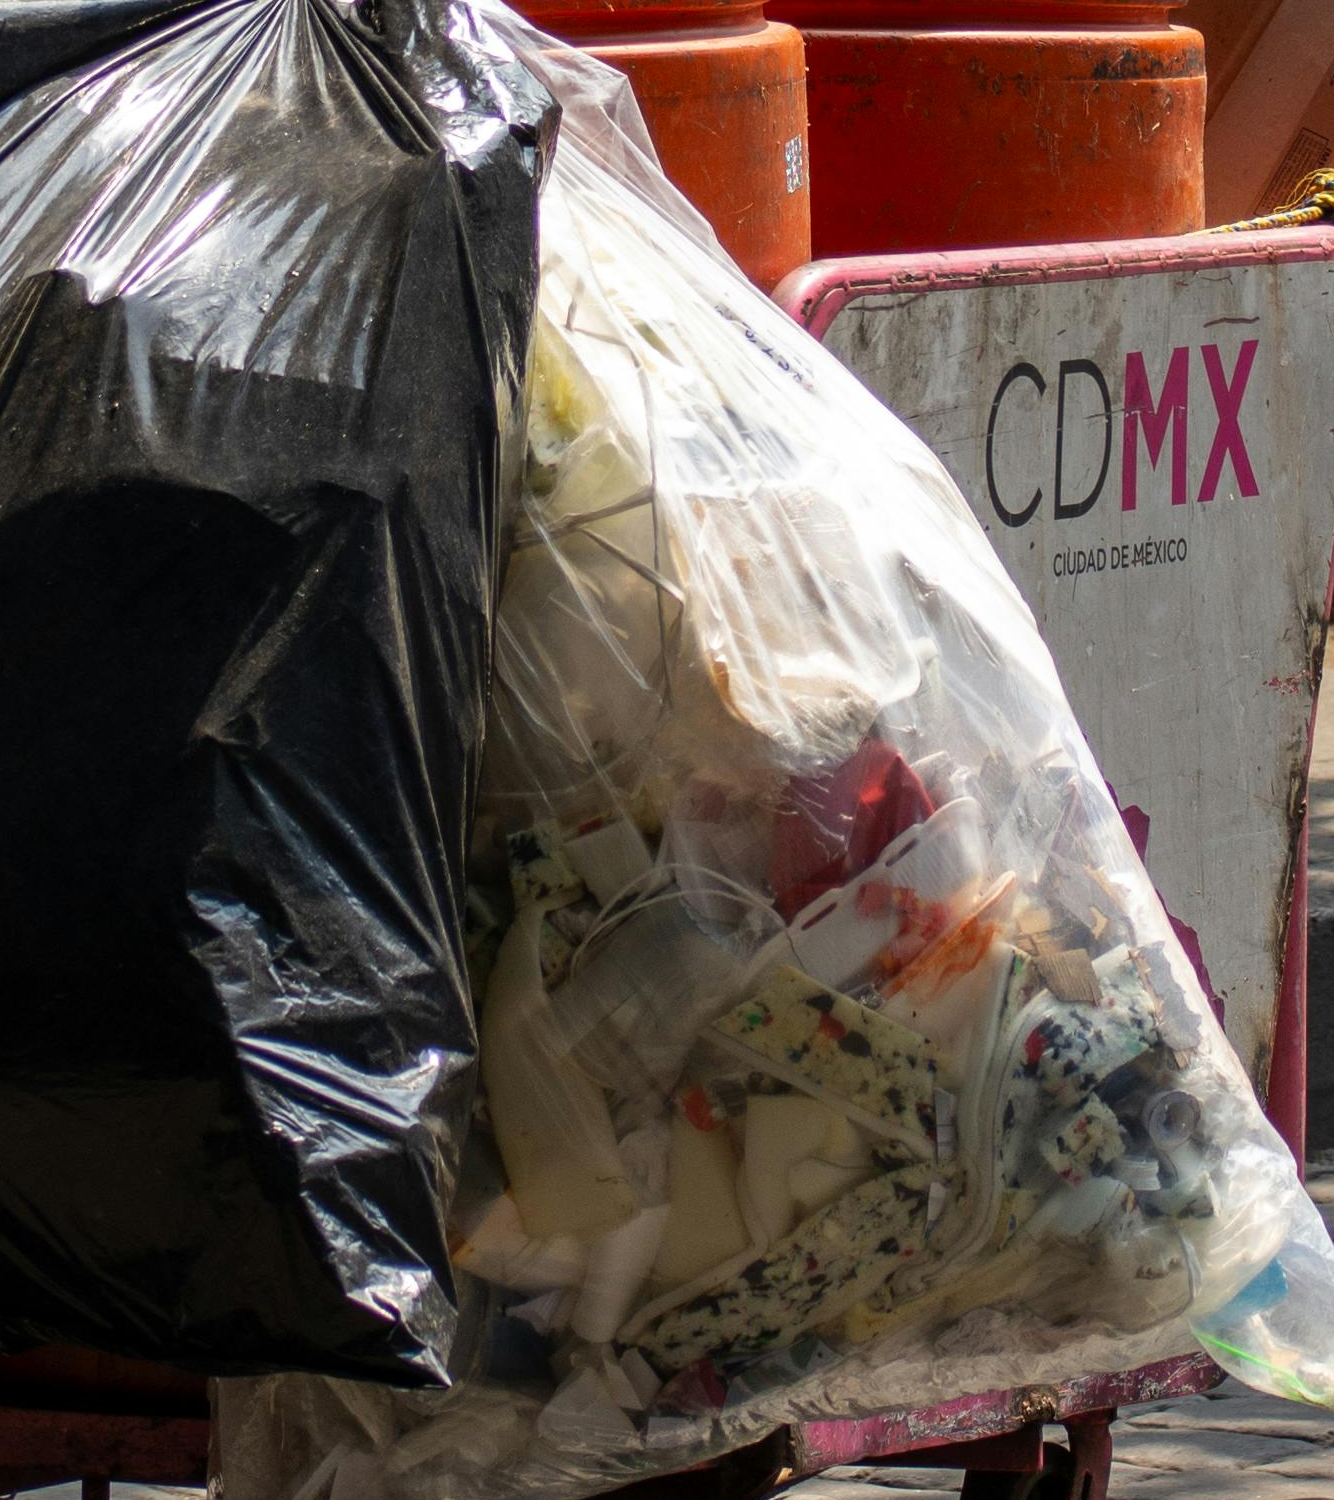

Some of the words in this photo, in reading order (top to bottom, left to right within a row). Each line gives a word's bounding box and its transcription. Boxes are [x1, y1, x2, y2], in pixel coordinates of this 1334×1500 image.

[986, 339, 1259, 528] CDMX
[1053, 548, 1107, 577] CIUDAD
[1110, 545, 1129, 570] DE
[1133, 536, 1188, 567] MÉXICO
